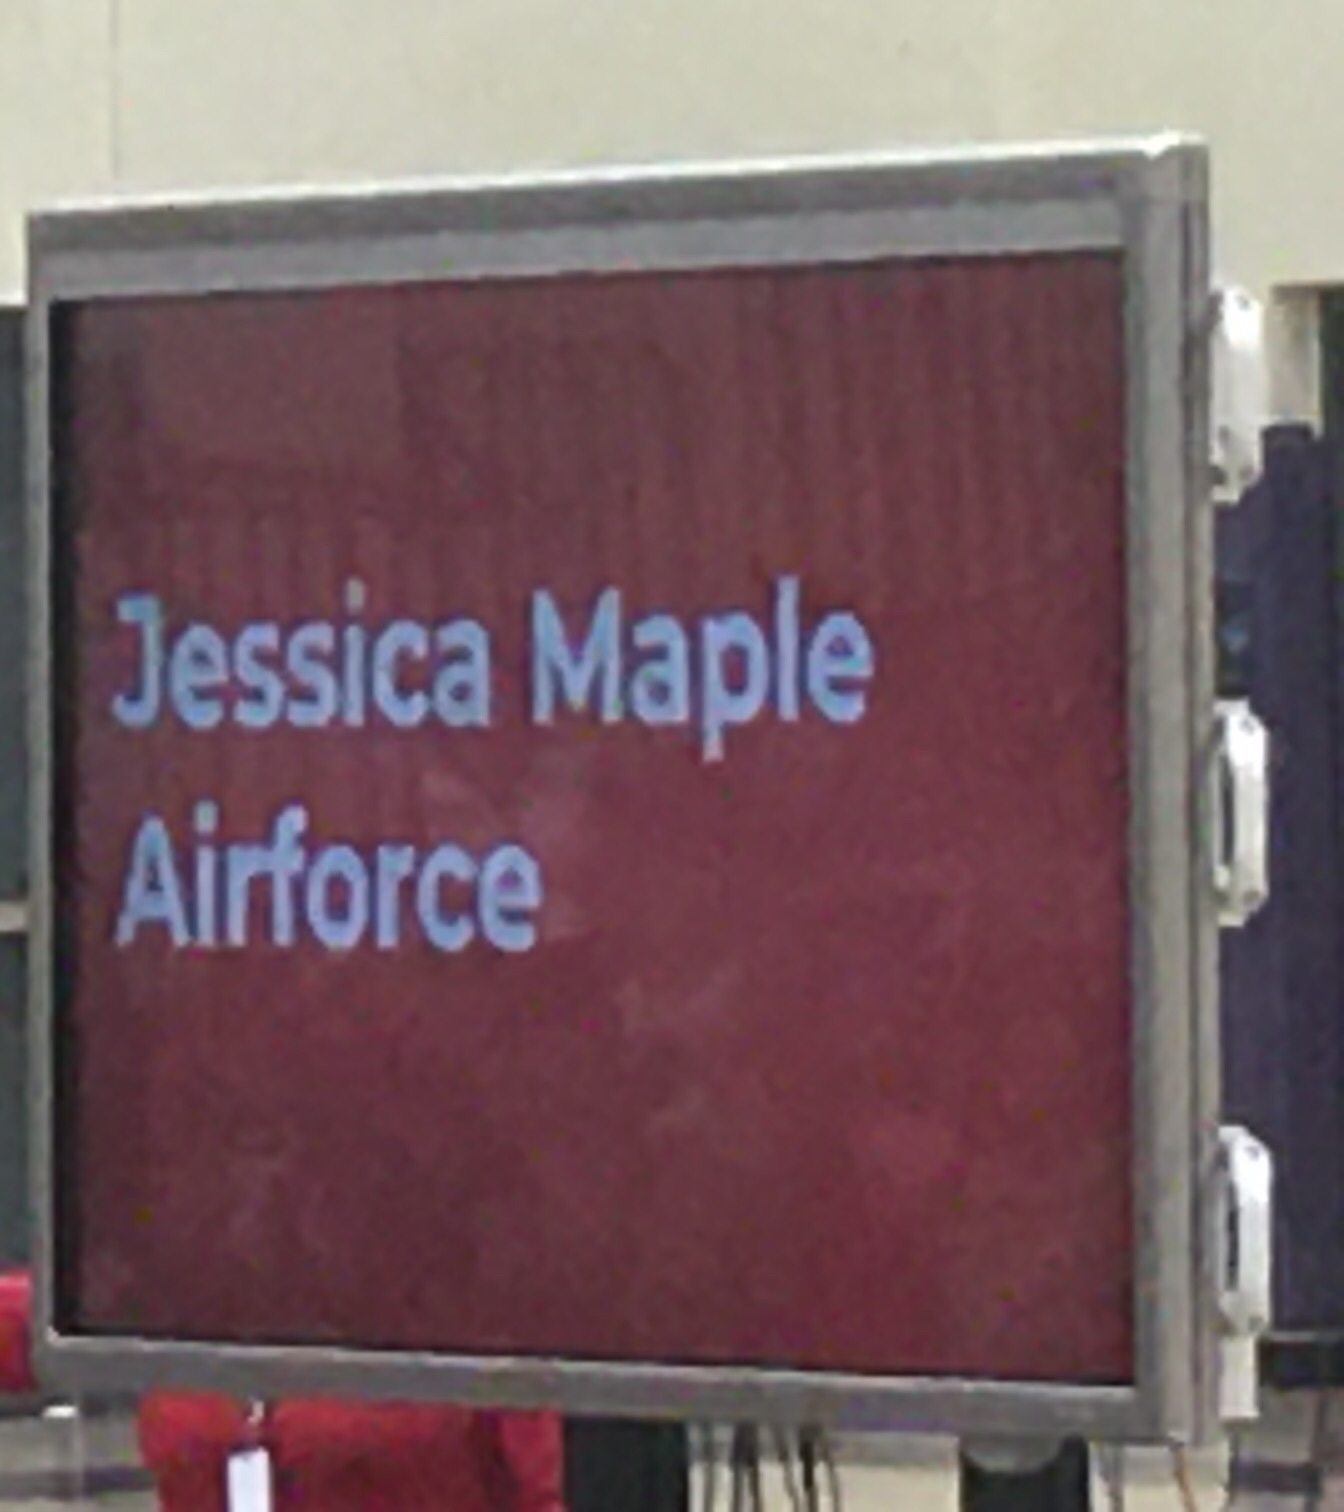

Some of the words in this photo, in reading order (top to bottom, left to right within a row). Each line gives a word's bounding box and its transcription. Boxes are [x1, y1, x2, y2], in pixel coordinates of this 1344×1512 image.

[112, 578, 491, 728] Jessica
[532, 574, 874, 761] Maple
[115, 800, 543, 953] Airforce
